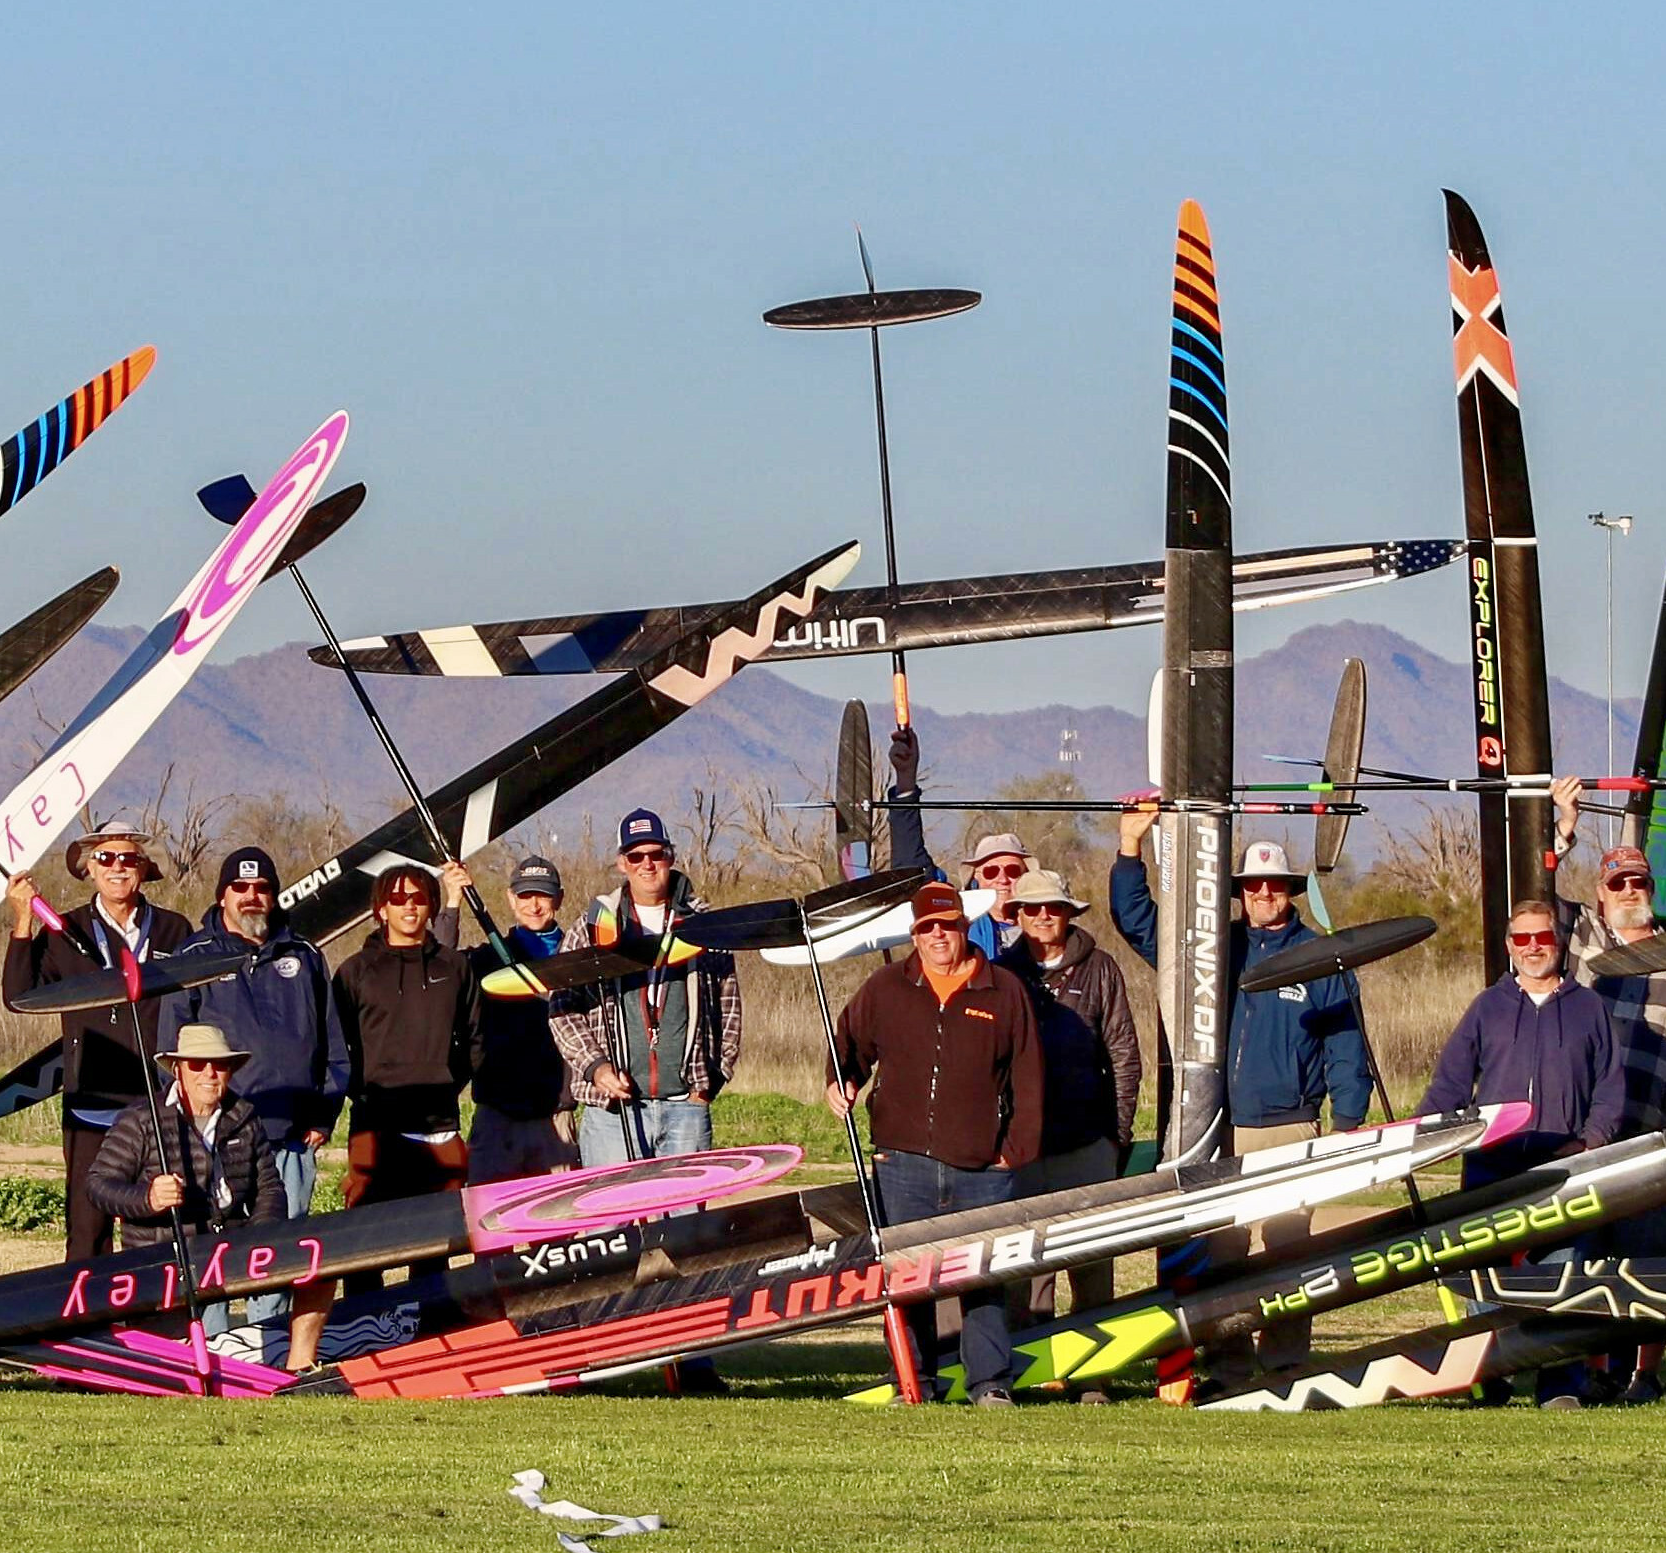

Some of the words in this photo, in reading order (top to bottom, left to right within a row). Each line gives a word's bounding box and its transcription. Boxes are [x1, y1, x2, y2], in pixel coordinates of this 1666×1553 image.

[774, 616, 886, 649] Ultim
[1471, 556, 1496, 726] EXPLORER
[1194, 825, 1219, 1001] PHOENIX
[1193, 1003, 1217, 1059] DF
[62, 1238, 323, 1317] Cayley
[520, 1231, 628, 1279] PLUSX
[737, 1229, 1035, 1330] BERKUT
[1351, 1185, 1603, 1287] PRESTIGE
